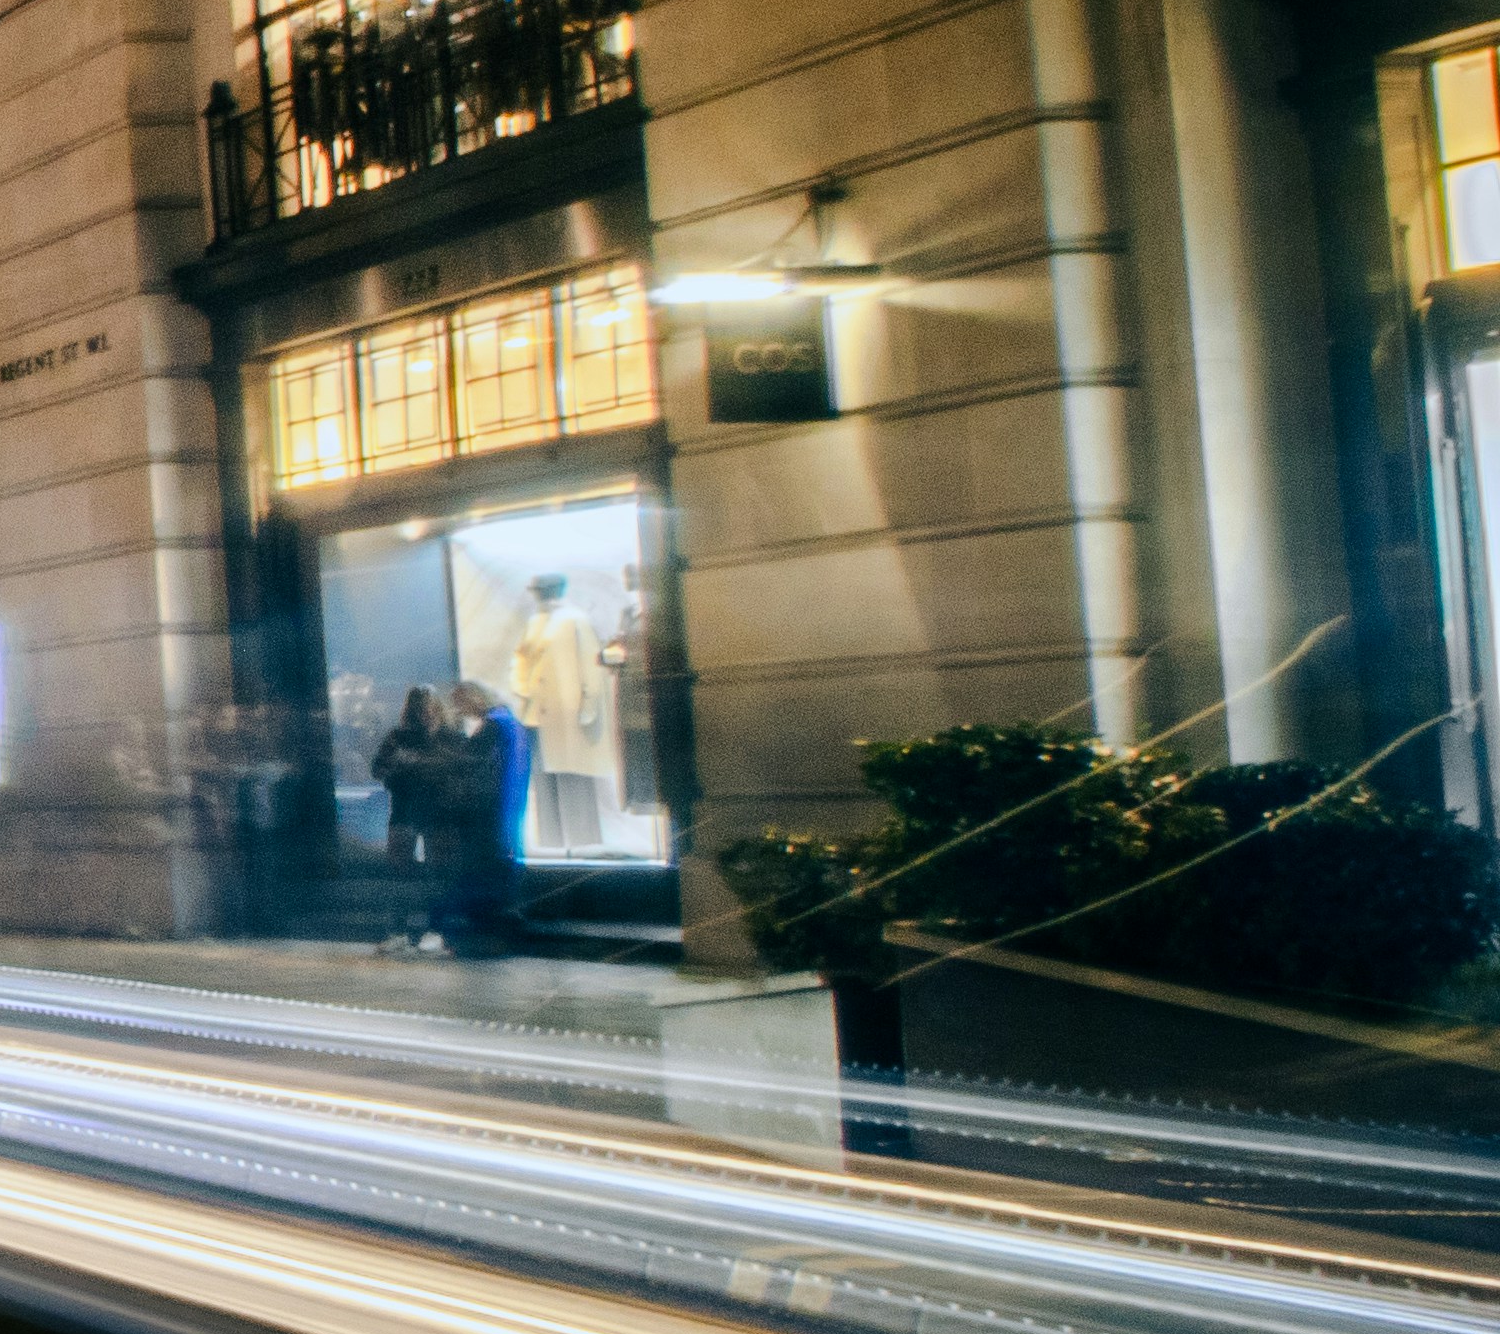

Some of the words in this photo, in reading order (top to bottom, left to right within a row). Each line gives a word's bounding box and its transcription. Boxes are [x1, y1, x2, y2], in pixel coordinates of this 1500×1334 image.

[0, 349, 55, 383] REGENT
[61, 341, 79, 365] ST
[733, 342, 814, 373] COS
